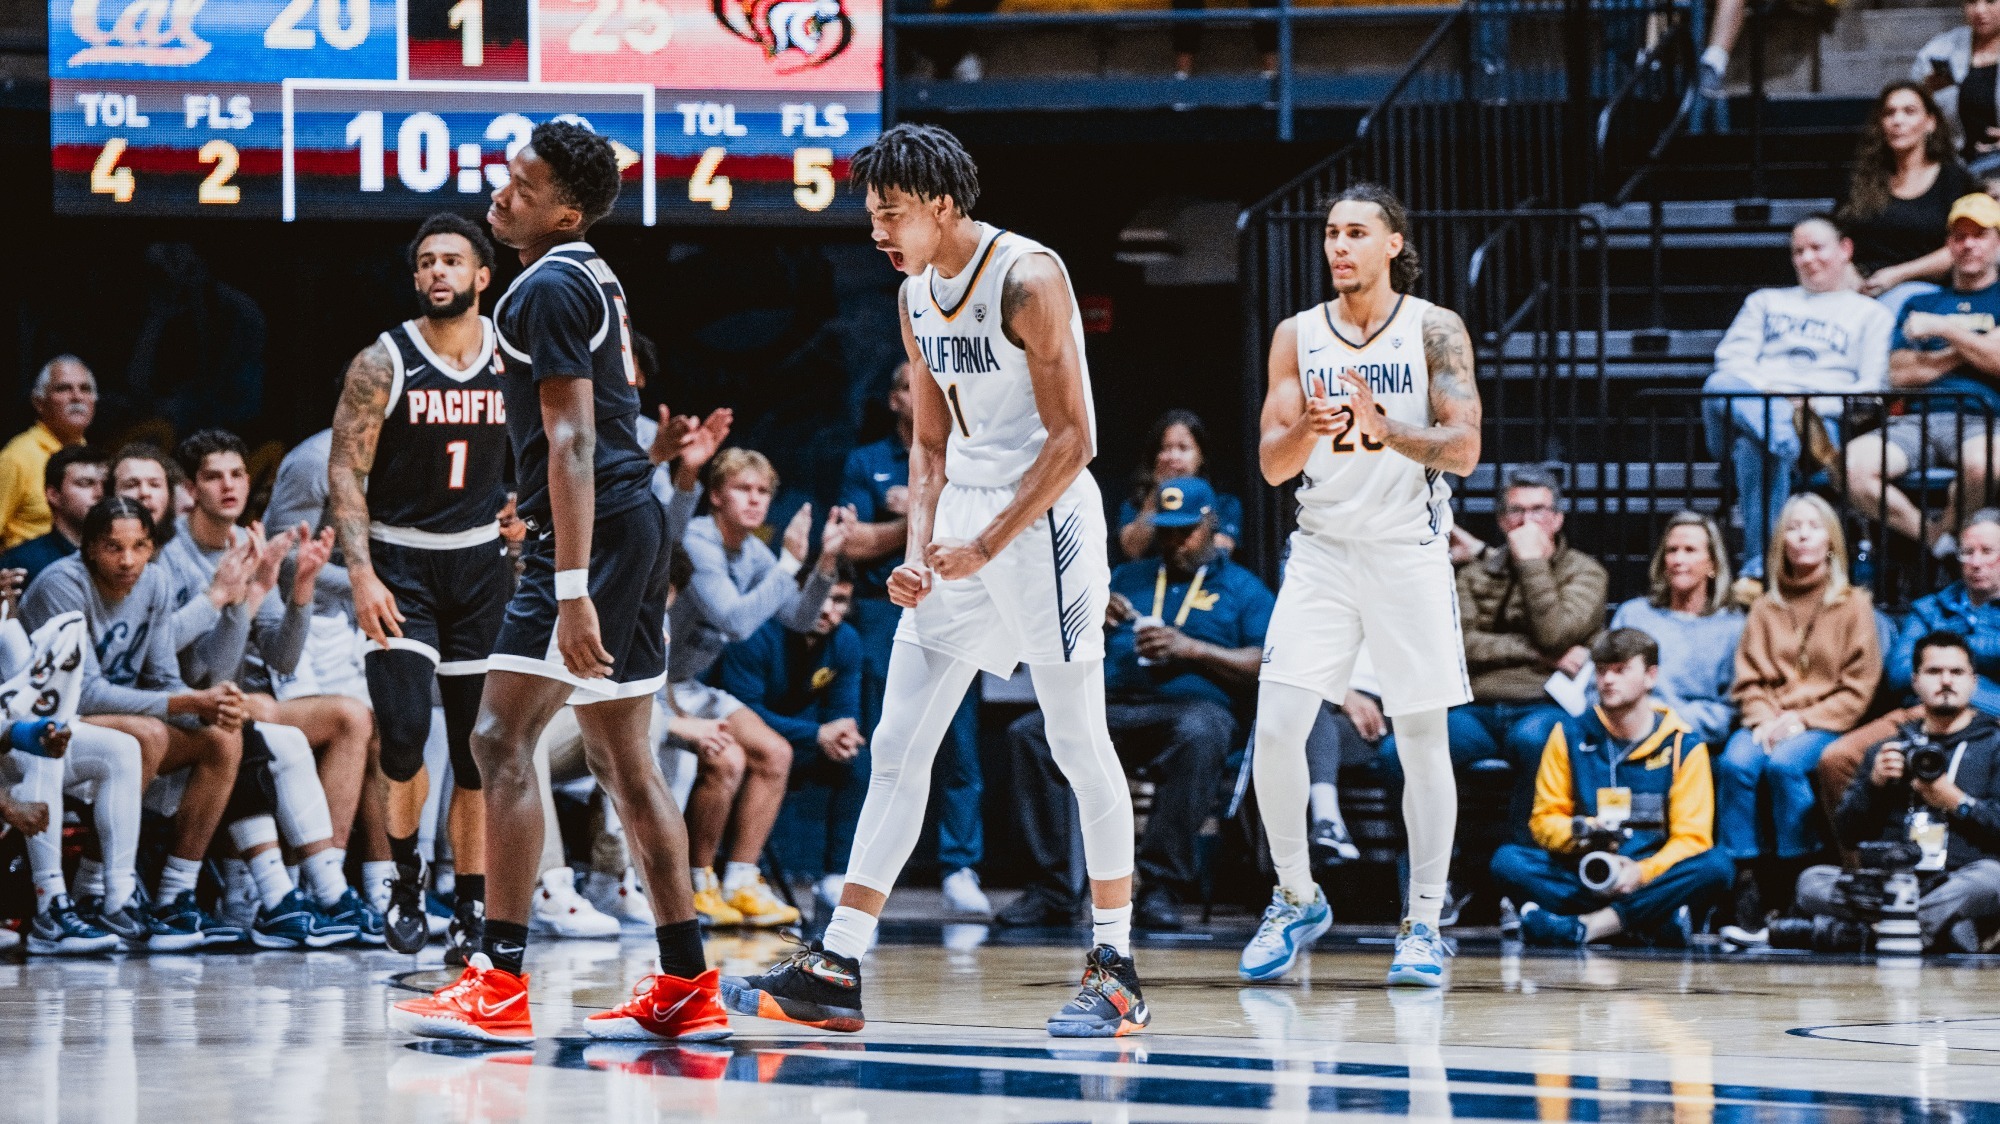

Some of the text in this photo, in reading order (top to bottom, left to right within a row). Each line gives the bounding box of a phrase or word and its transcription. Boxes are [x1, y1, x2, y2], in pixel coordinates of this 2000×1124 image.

[264, 0, 371, 50] 20
[447, 0, 483, 67] 1
[569, 0, 673, 53] 25
[76, 93, 254, 129] TOL FLS
[676, 102, 849, 137] TOL FLS
[91, 138, 240, 204] 4 2
[346, 111, 598, 193] 10:3
[688, 146, 835, 212] 4 5
[407, 389, 507, 424] PACIFIC
[948, 384, 970, 438] 1
[446, 440, 468, 489] 1
